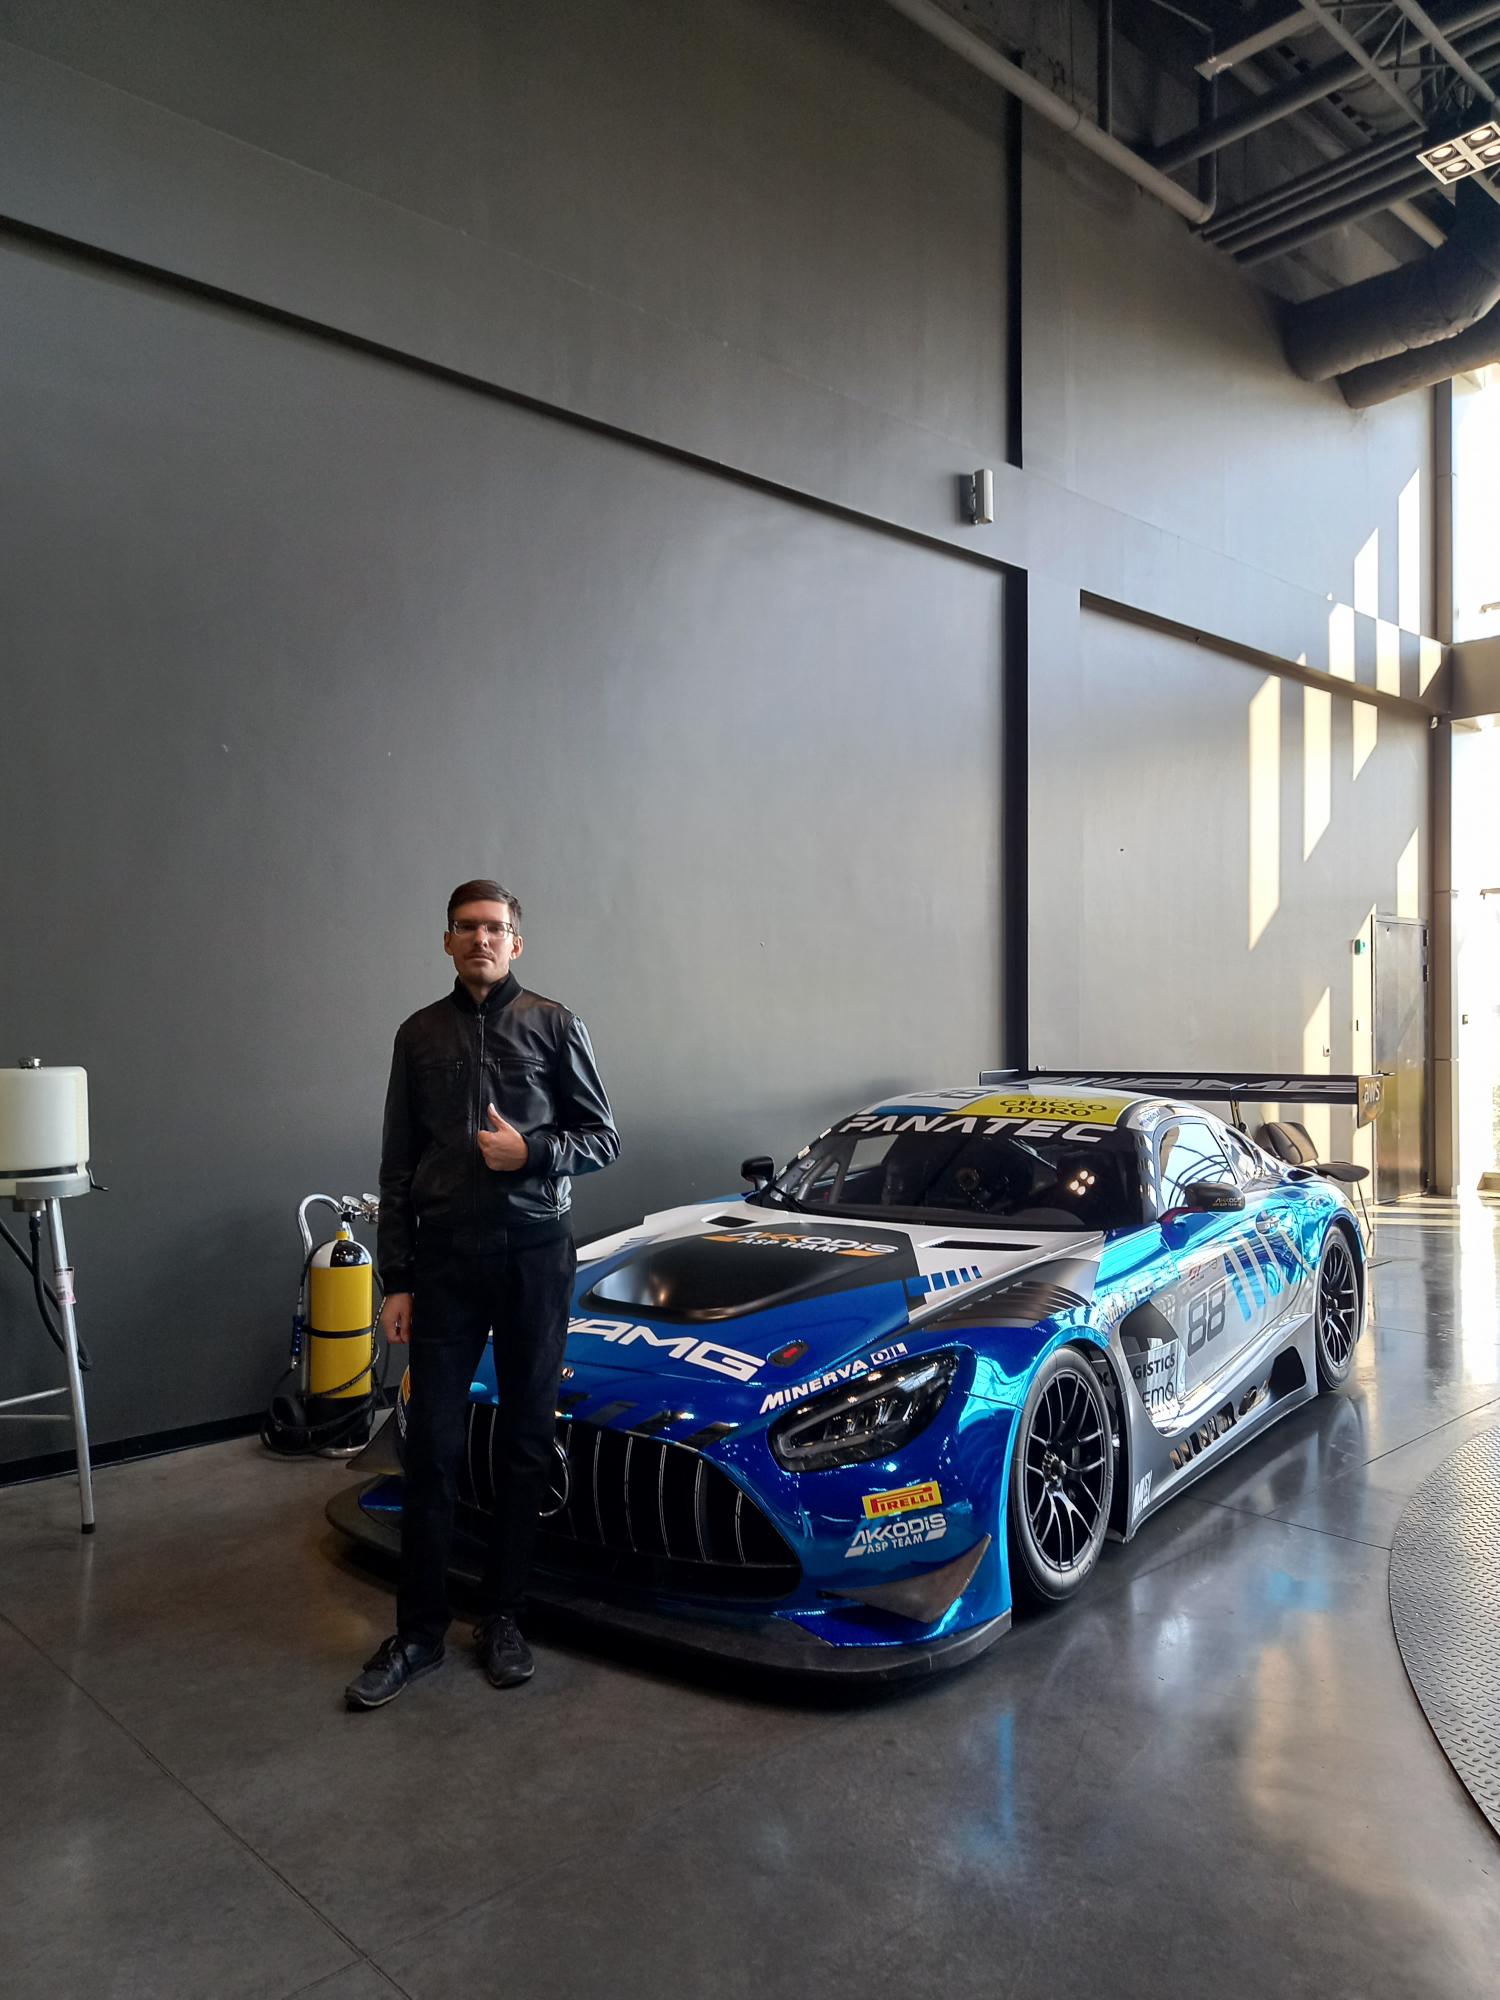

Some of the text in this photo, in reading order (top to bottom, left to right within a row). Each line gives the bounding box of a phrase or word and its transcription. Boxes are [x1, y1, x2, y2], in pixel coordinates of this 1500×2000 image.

[1000, 1099, 1107, 1111] CHICCO
[839, 1114, 1117, 1143] FANATEC
[1187, 1285, 1226, 1357] 88
[566, 1319, 766, 1382] AMG
[759, 1342, 908, 1414] MINERVA OIL
[870, 1486, 934, 1514] PIRELLI
[867, 1535, 923, 1555] ASP TEAM
